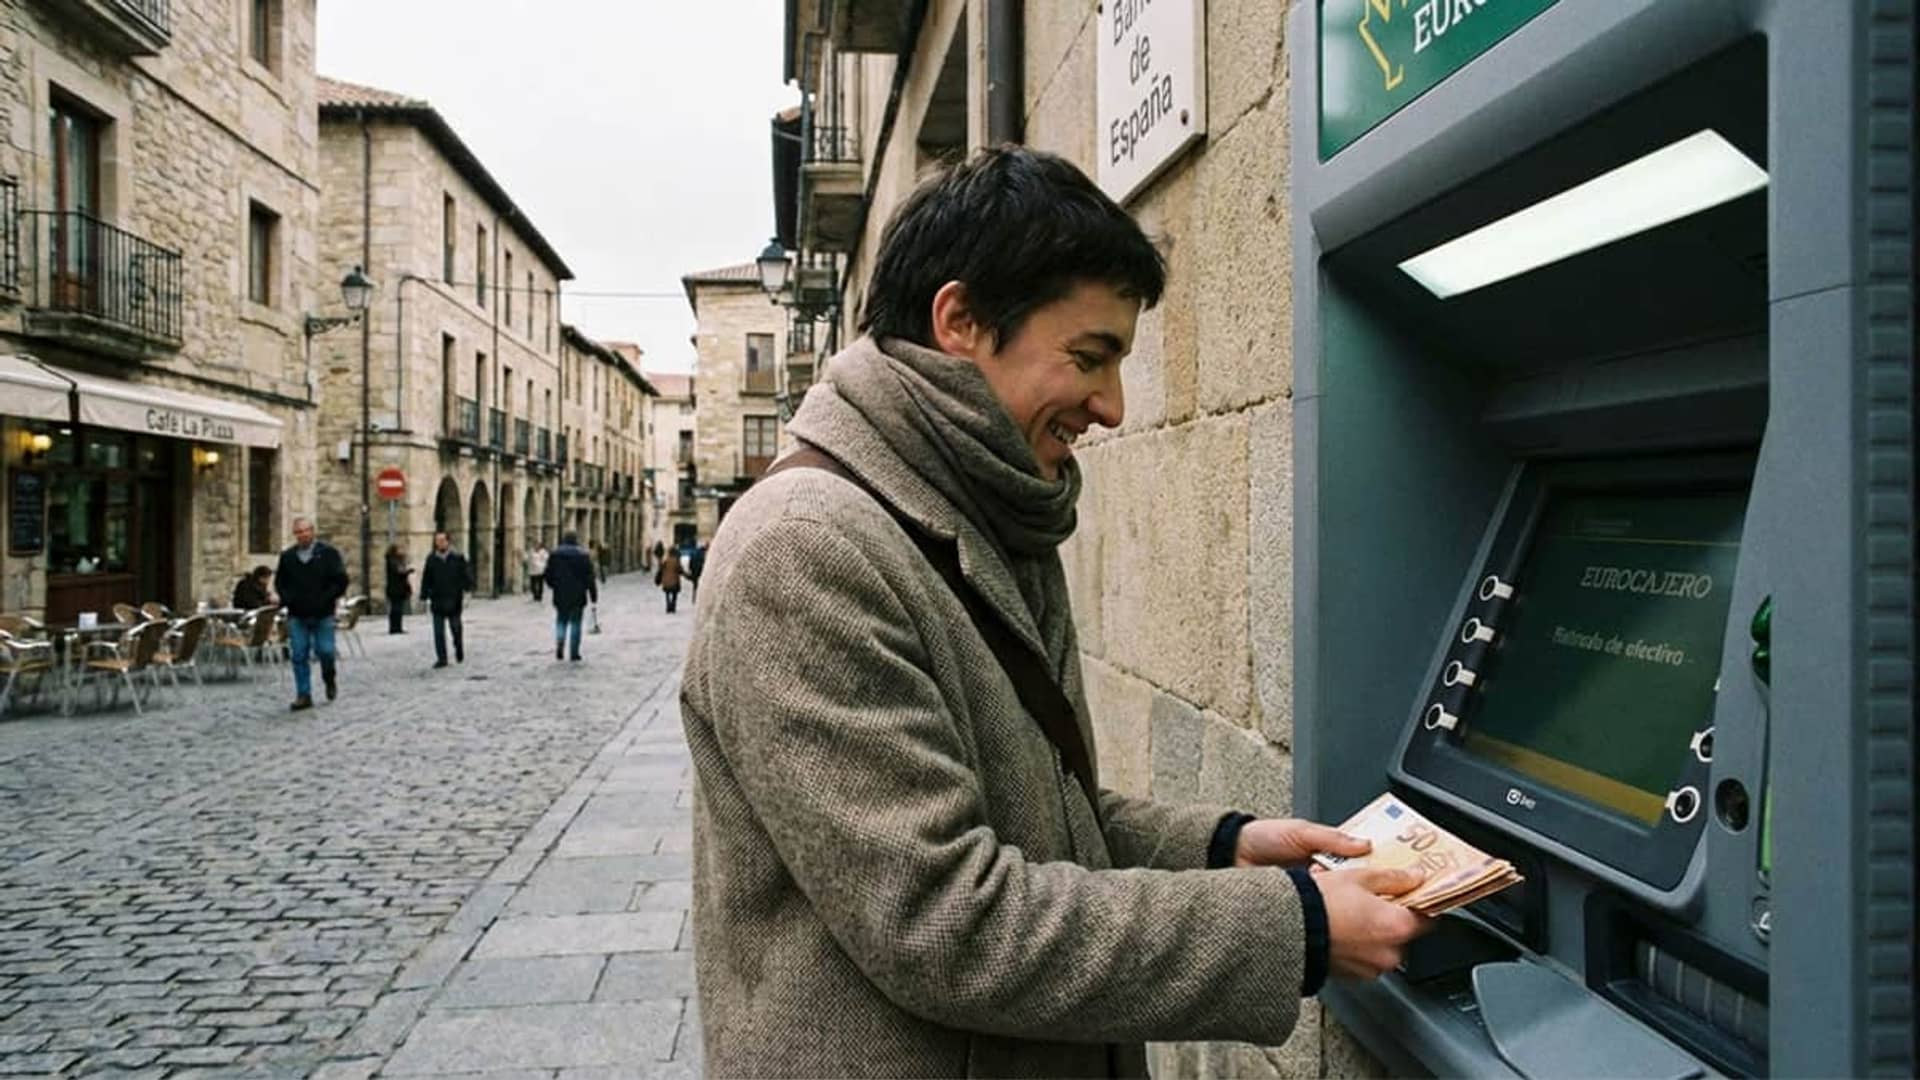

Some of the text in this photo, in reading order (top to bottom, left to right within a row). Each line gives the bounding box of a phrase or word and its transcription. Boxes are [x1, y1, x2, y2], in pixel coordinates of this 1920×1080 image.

[1113, 0, 1152, 46] Ban
[1413, 0, 1486, 54] EUR
[1129, 34, 1151, 86] de
[1110, 73, 1173, 167] España
[182, 413, 198, 436] La
[1580, 566, 1713, 599] EUROCAJERO
